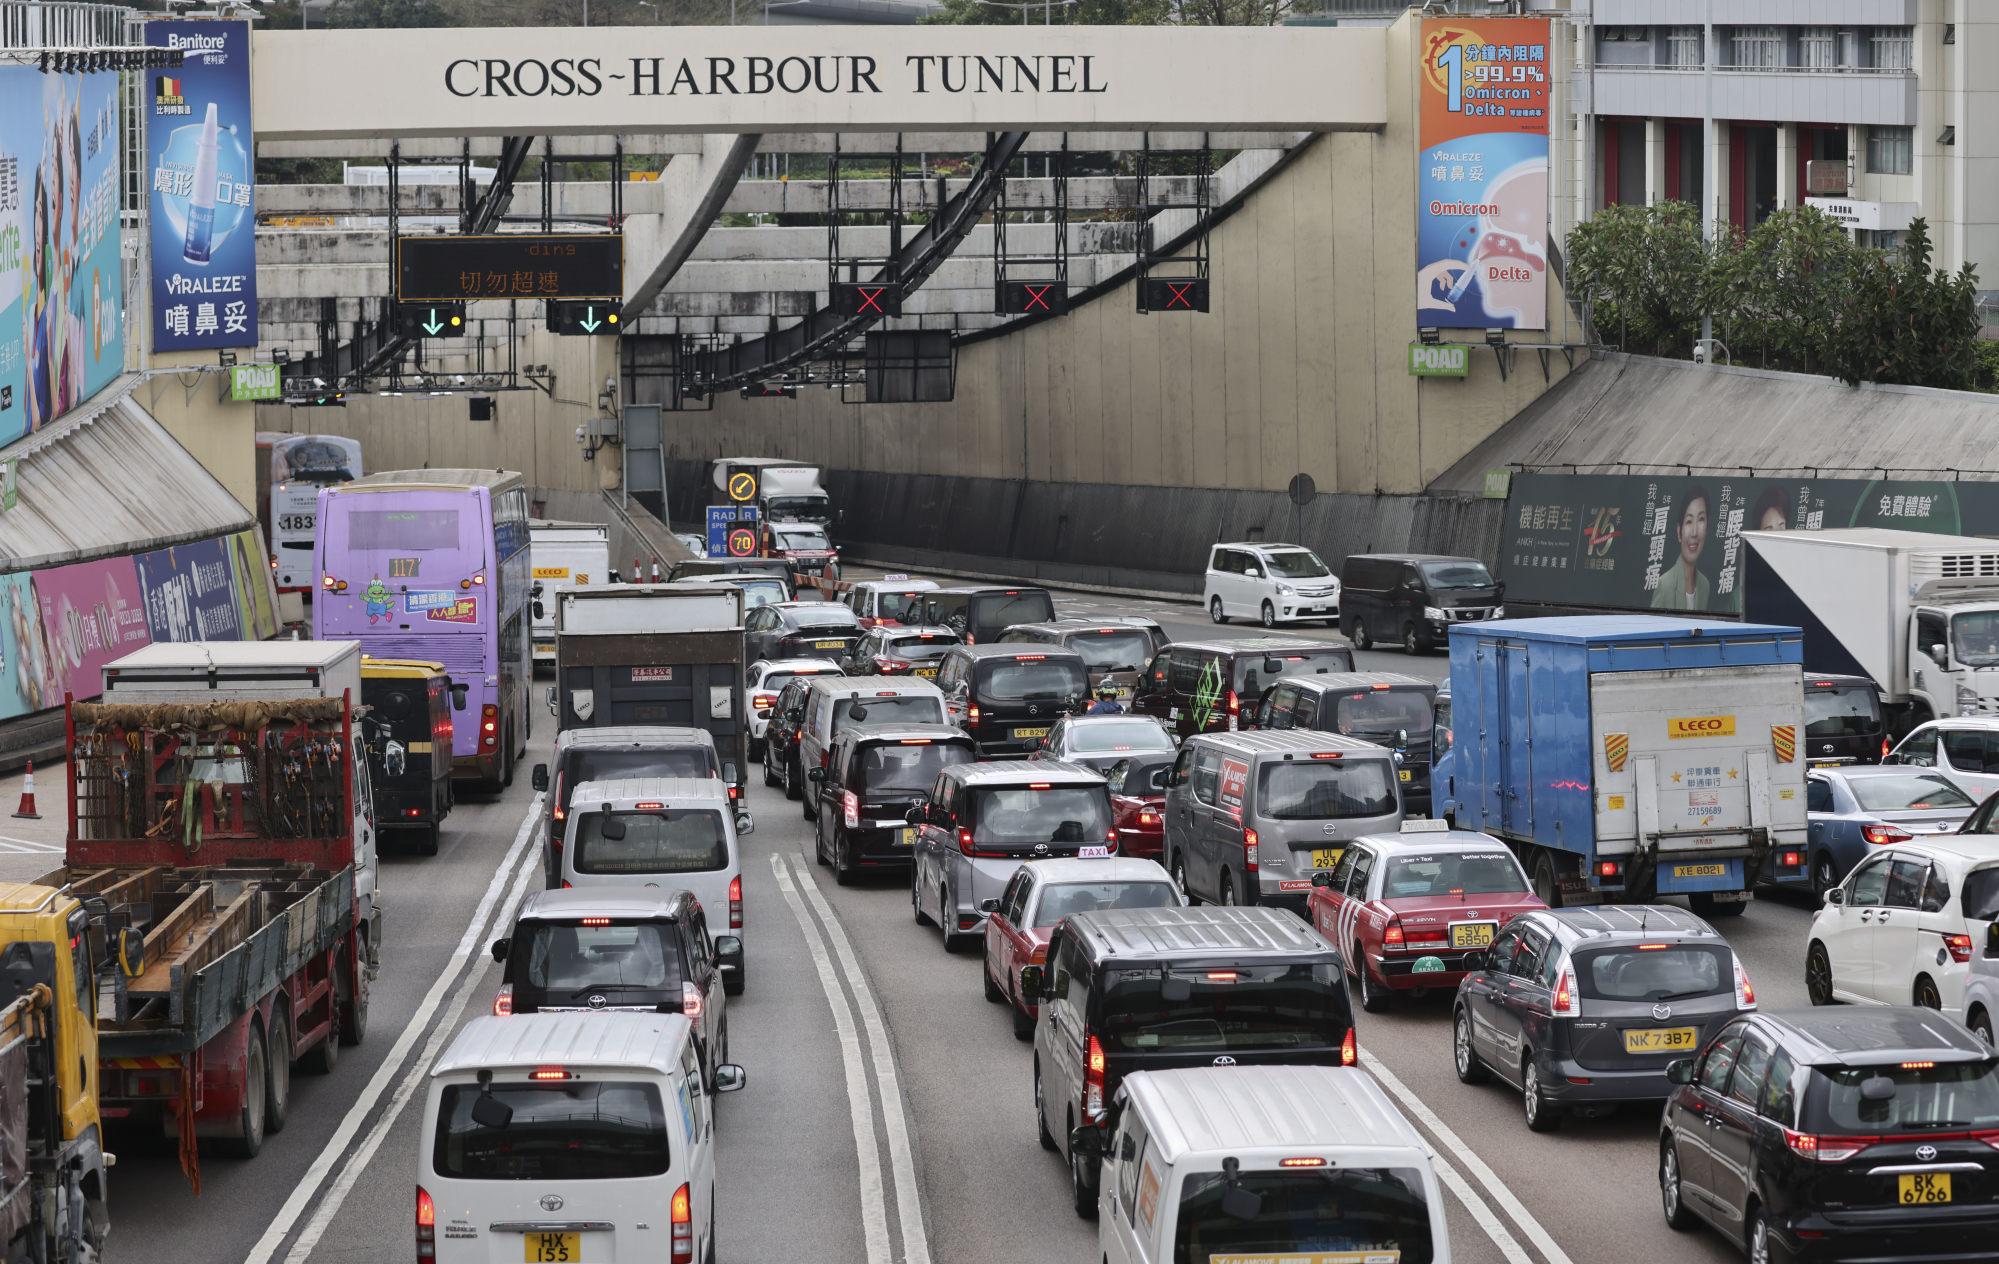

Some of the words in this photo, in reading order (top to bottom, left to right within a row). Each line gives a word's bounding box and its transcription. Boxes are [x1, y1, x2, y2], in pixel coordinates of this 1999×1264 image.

[168, 33, 225, 49] Banitore
[1465, 44, 1545, 62] 分鐘內阻隔
[905, 55, 1109, 93] TUNNEL
[1464, 65, 1545, 82] >99.9%
[156, 105, 192, 115] 比利時製造
[1465, 102, 1505, 116] Delta
[1431, 165, 1485, 182] 噴鼻妥
[153, 167, 193, 197] 隱形
[216, 181, 252, 208] 口罩
[1430, 201, 1498, 216] Omicron
[1488, 265, 1531, 280] Delta
[460, 270, 559, 294] 切勿超速
[165, 300, 248, 337] 噴鼻妥
[1413, 348, 1464, 369] POAD
[236, 367, 276, 390] POAD
[1877, 494, 1933, 518] 免費體驗
[712, 511, 752, 520] RADR
[1520, 504, 1574, 531] 機能再生
[734, 537, 751, 550] 70
[1643, 505, 1671, 591] 肩頸痛
[1717, 508, 1745, 594] 腰背痛
[393, 559, 415, 577] 117
[1016, 729, 1027, 737] RT
[1678, 719, 1723, 732] LEEO
[1775, 737, 1793, 749] LEEO
[1609, 746, 1625, 759] LEEO
[1687, 806, 1722, 816] 27159689
[1081, 848, 1107, 857] TAXI
[1322, 849, 1336, 859] UL
[1315, 858, 1337, 868] 293
[1679, 867, 1694, 876] XE
[1697, 865, 1721, 875] 8021
[1464, 926, 1480, 936] SV
[1457, 934, 1491, 946] 5850
[1629, 1035, 1650, 1047] NK
[1914, 1175, 1935, 1188] RK
[1903, 1188, 1947, 1203] 6766
[540, 1233, 565, 1248] HX
[537, 1248, 569, 1262] 155
